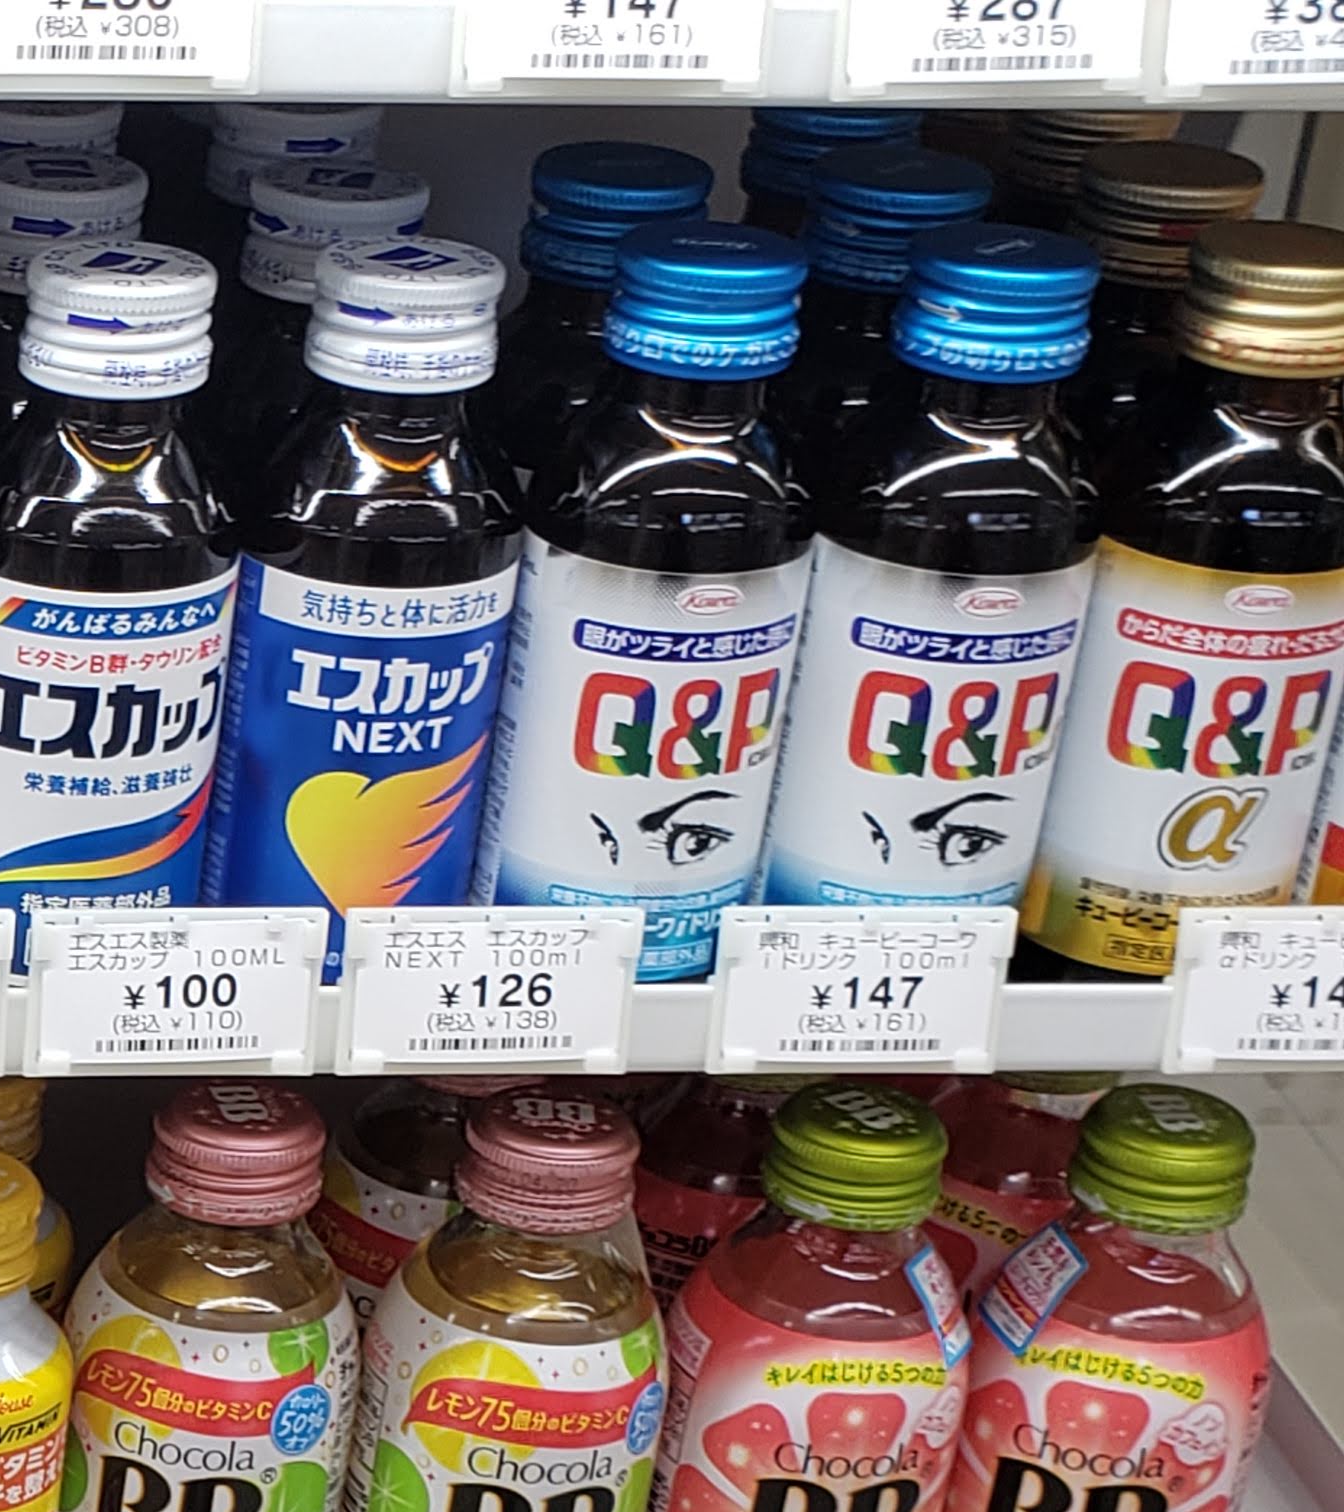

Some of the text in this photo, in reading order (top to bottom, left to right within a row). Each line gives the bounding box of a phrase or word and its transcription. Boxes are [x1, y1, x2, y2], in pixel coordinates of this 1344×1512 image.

[99, 15, 178, 38] ¥308)
[998, 25, 1076, 48] ¥315)
[34, 601, 216, 635] がんばるみんなへ
[287, 642, 494, 715] エスカップ
[333, 716, 453, 755] NEXT
[848, 670, 1060, 780] Q&P
[1107, 661, 1332, 779] Q&P
[194, 948, 285, 966] 100ML
[125, 973, 238, 1010] ¥100
[440, 973, 552, 1008] ¥126
[811, 976, 923, 1011] ¥147
[485, 1011, 557, 1032] ¥138)
[114, 1422, 255, 1473] Chocola
[774, 1442, 919, 1477] Chocola
[1013, 1425, 1164, 1478] Chocola
[468, 1448, 612, 1486] Chocola
